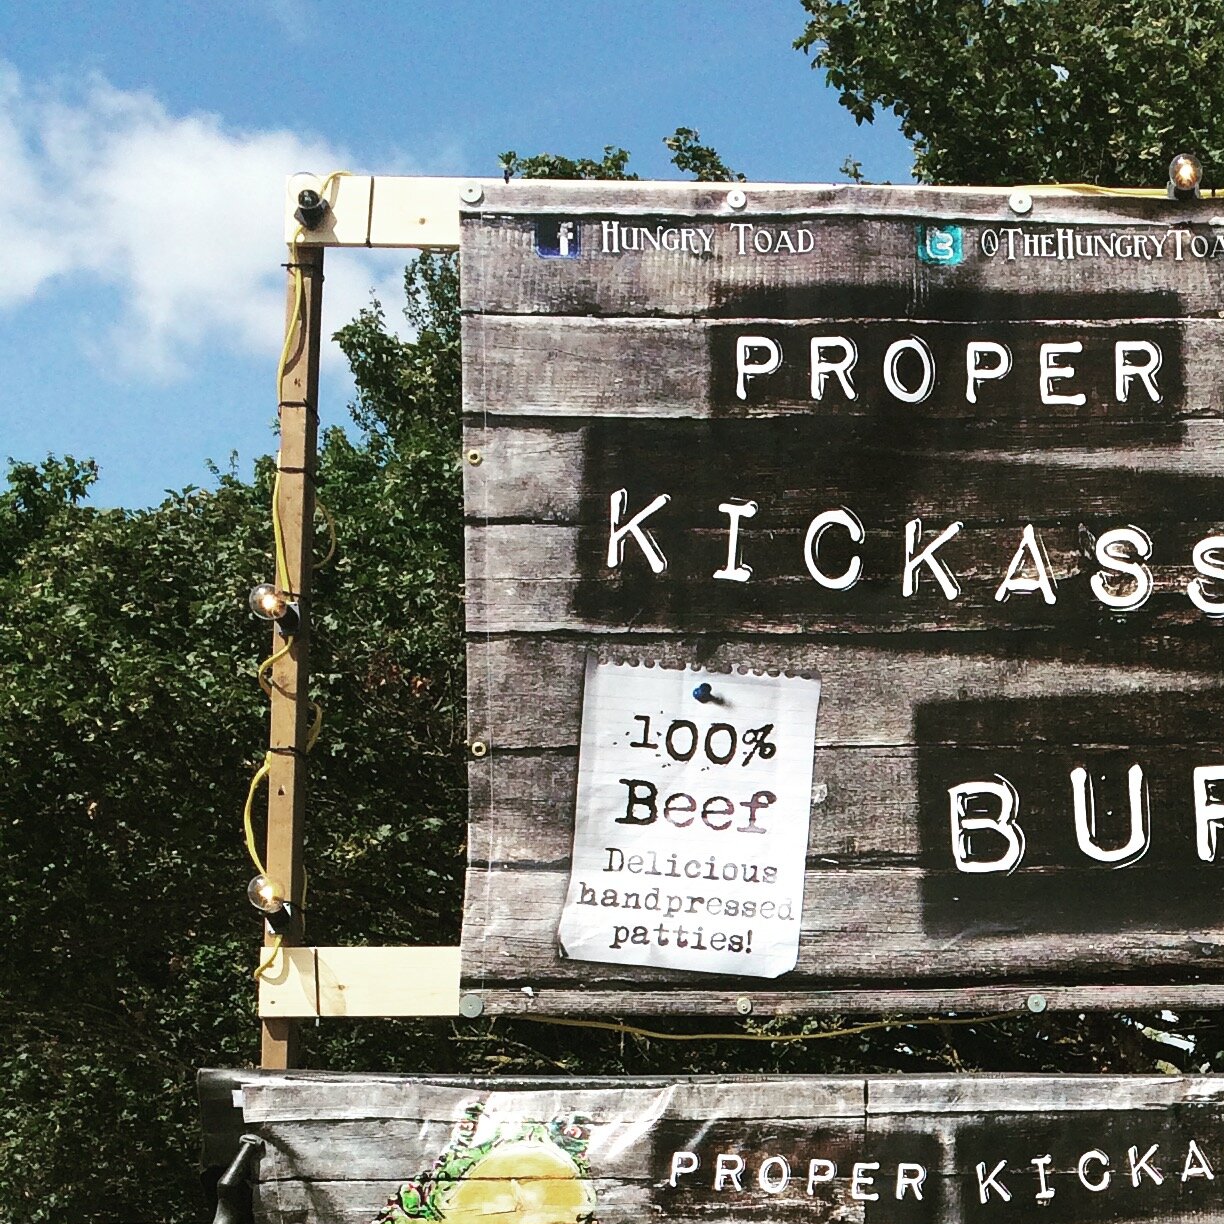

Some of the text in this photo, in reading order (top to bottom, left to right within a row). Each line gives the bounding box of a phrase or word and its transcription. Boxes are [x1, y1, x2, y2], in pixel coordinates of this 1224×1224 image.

[601, 220, 815, 255] HUNGRY TOAD
[733, 333, 1165, 405] PROPER
[628, 714, 778, 767] 100%
[613, 777, 779, 835] Beef
[602, 846, 780, 884] Delicious
[575, 881, 796, 923] handpressed
[608, 922, 754, 955] patties!
[668, 1150, 926, 1202] PROPER
